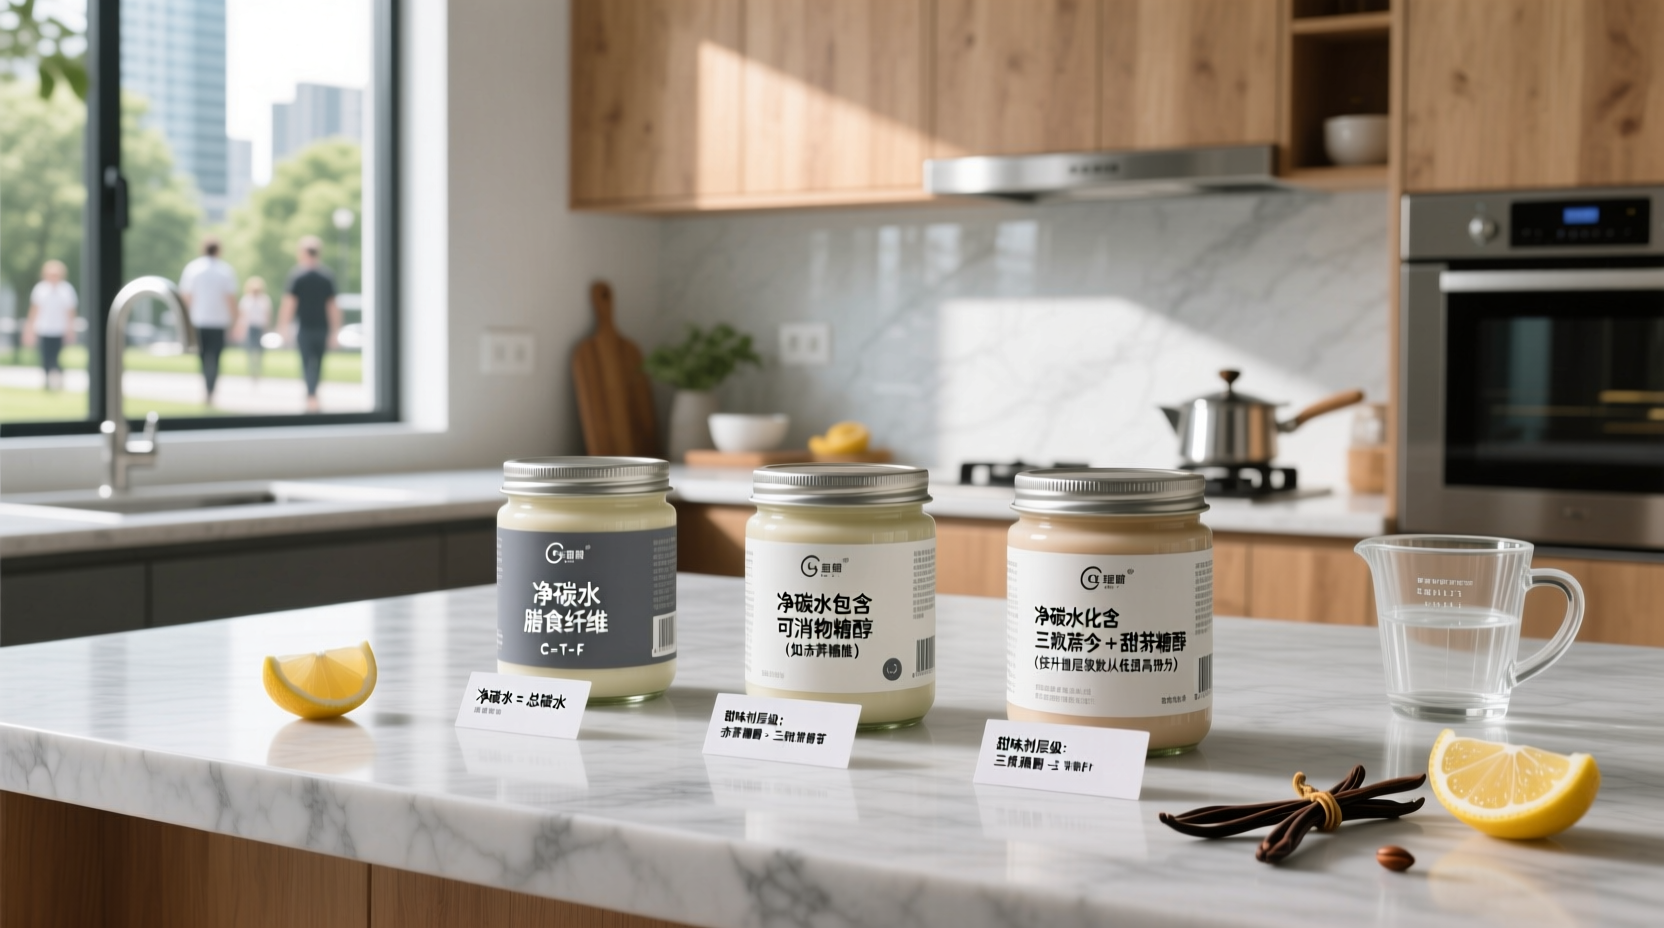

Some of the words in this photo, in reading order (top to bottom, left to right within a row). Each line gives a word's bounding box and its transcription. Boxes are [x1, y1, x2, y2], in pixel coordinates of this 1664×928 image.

[532, 580, 601, 607] 净碳水
[777, 591, 873, 615] 净碳水包含
